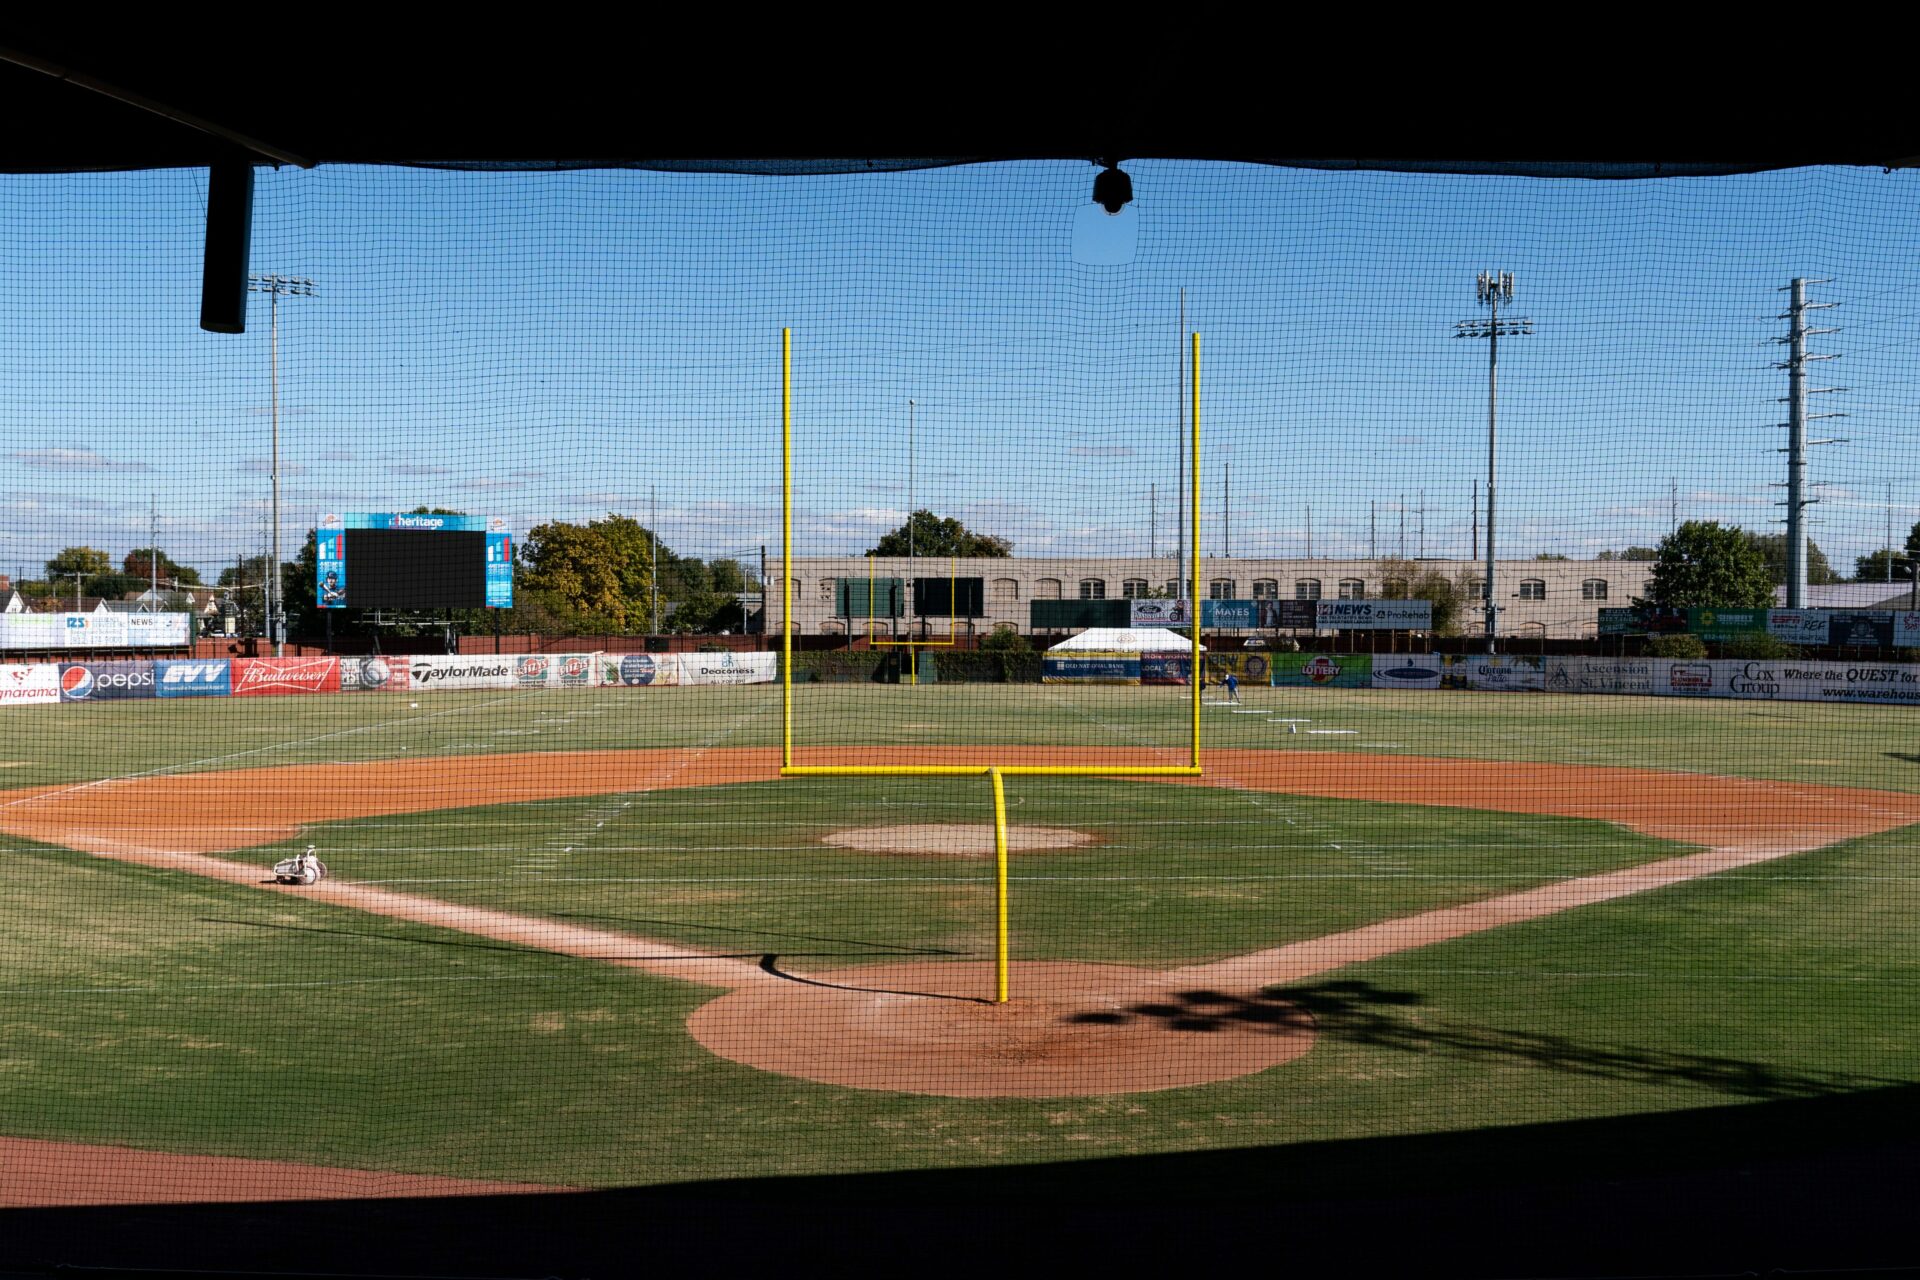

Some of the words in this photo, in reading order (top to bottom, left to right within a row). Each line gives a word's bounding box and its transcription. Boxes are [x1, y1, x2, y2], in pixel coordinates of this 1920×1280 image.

[398, 514, 444, 530] heritage
[1215, 608, 1250, 616] MAYES
[1334, 604, 1372, 615] NEWS
[1387, 610, 1430, 619] ProRehab
[131, 617, 153, 627] NEWS
[1803, 620, 1826, 631] REF
[162, 664, 227, 683] EVV
[243, 665, 329, 684] Budweiser
[411, 662, 508, 682] TaylorMade
[701, 667, 755, 675] Deaconess
[1301, 666, 1341, 676] LOTTERY
[1583, 662, 1648, 675] Ascension
[1744, 662, 1775, 682] Cox
[97, 669, 155, 691] pepsi
[1783, 668, 1822, 680] Where
[1825, 670, 1843, 681] the
[1846, 668, 1899, 682] QUEST
[1901, 672, 1918, 683] for
[1600, 678, 1652, 689] Vincent
[1730, 674, 1780, 698] Group
